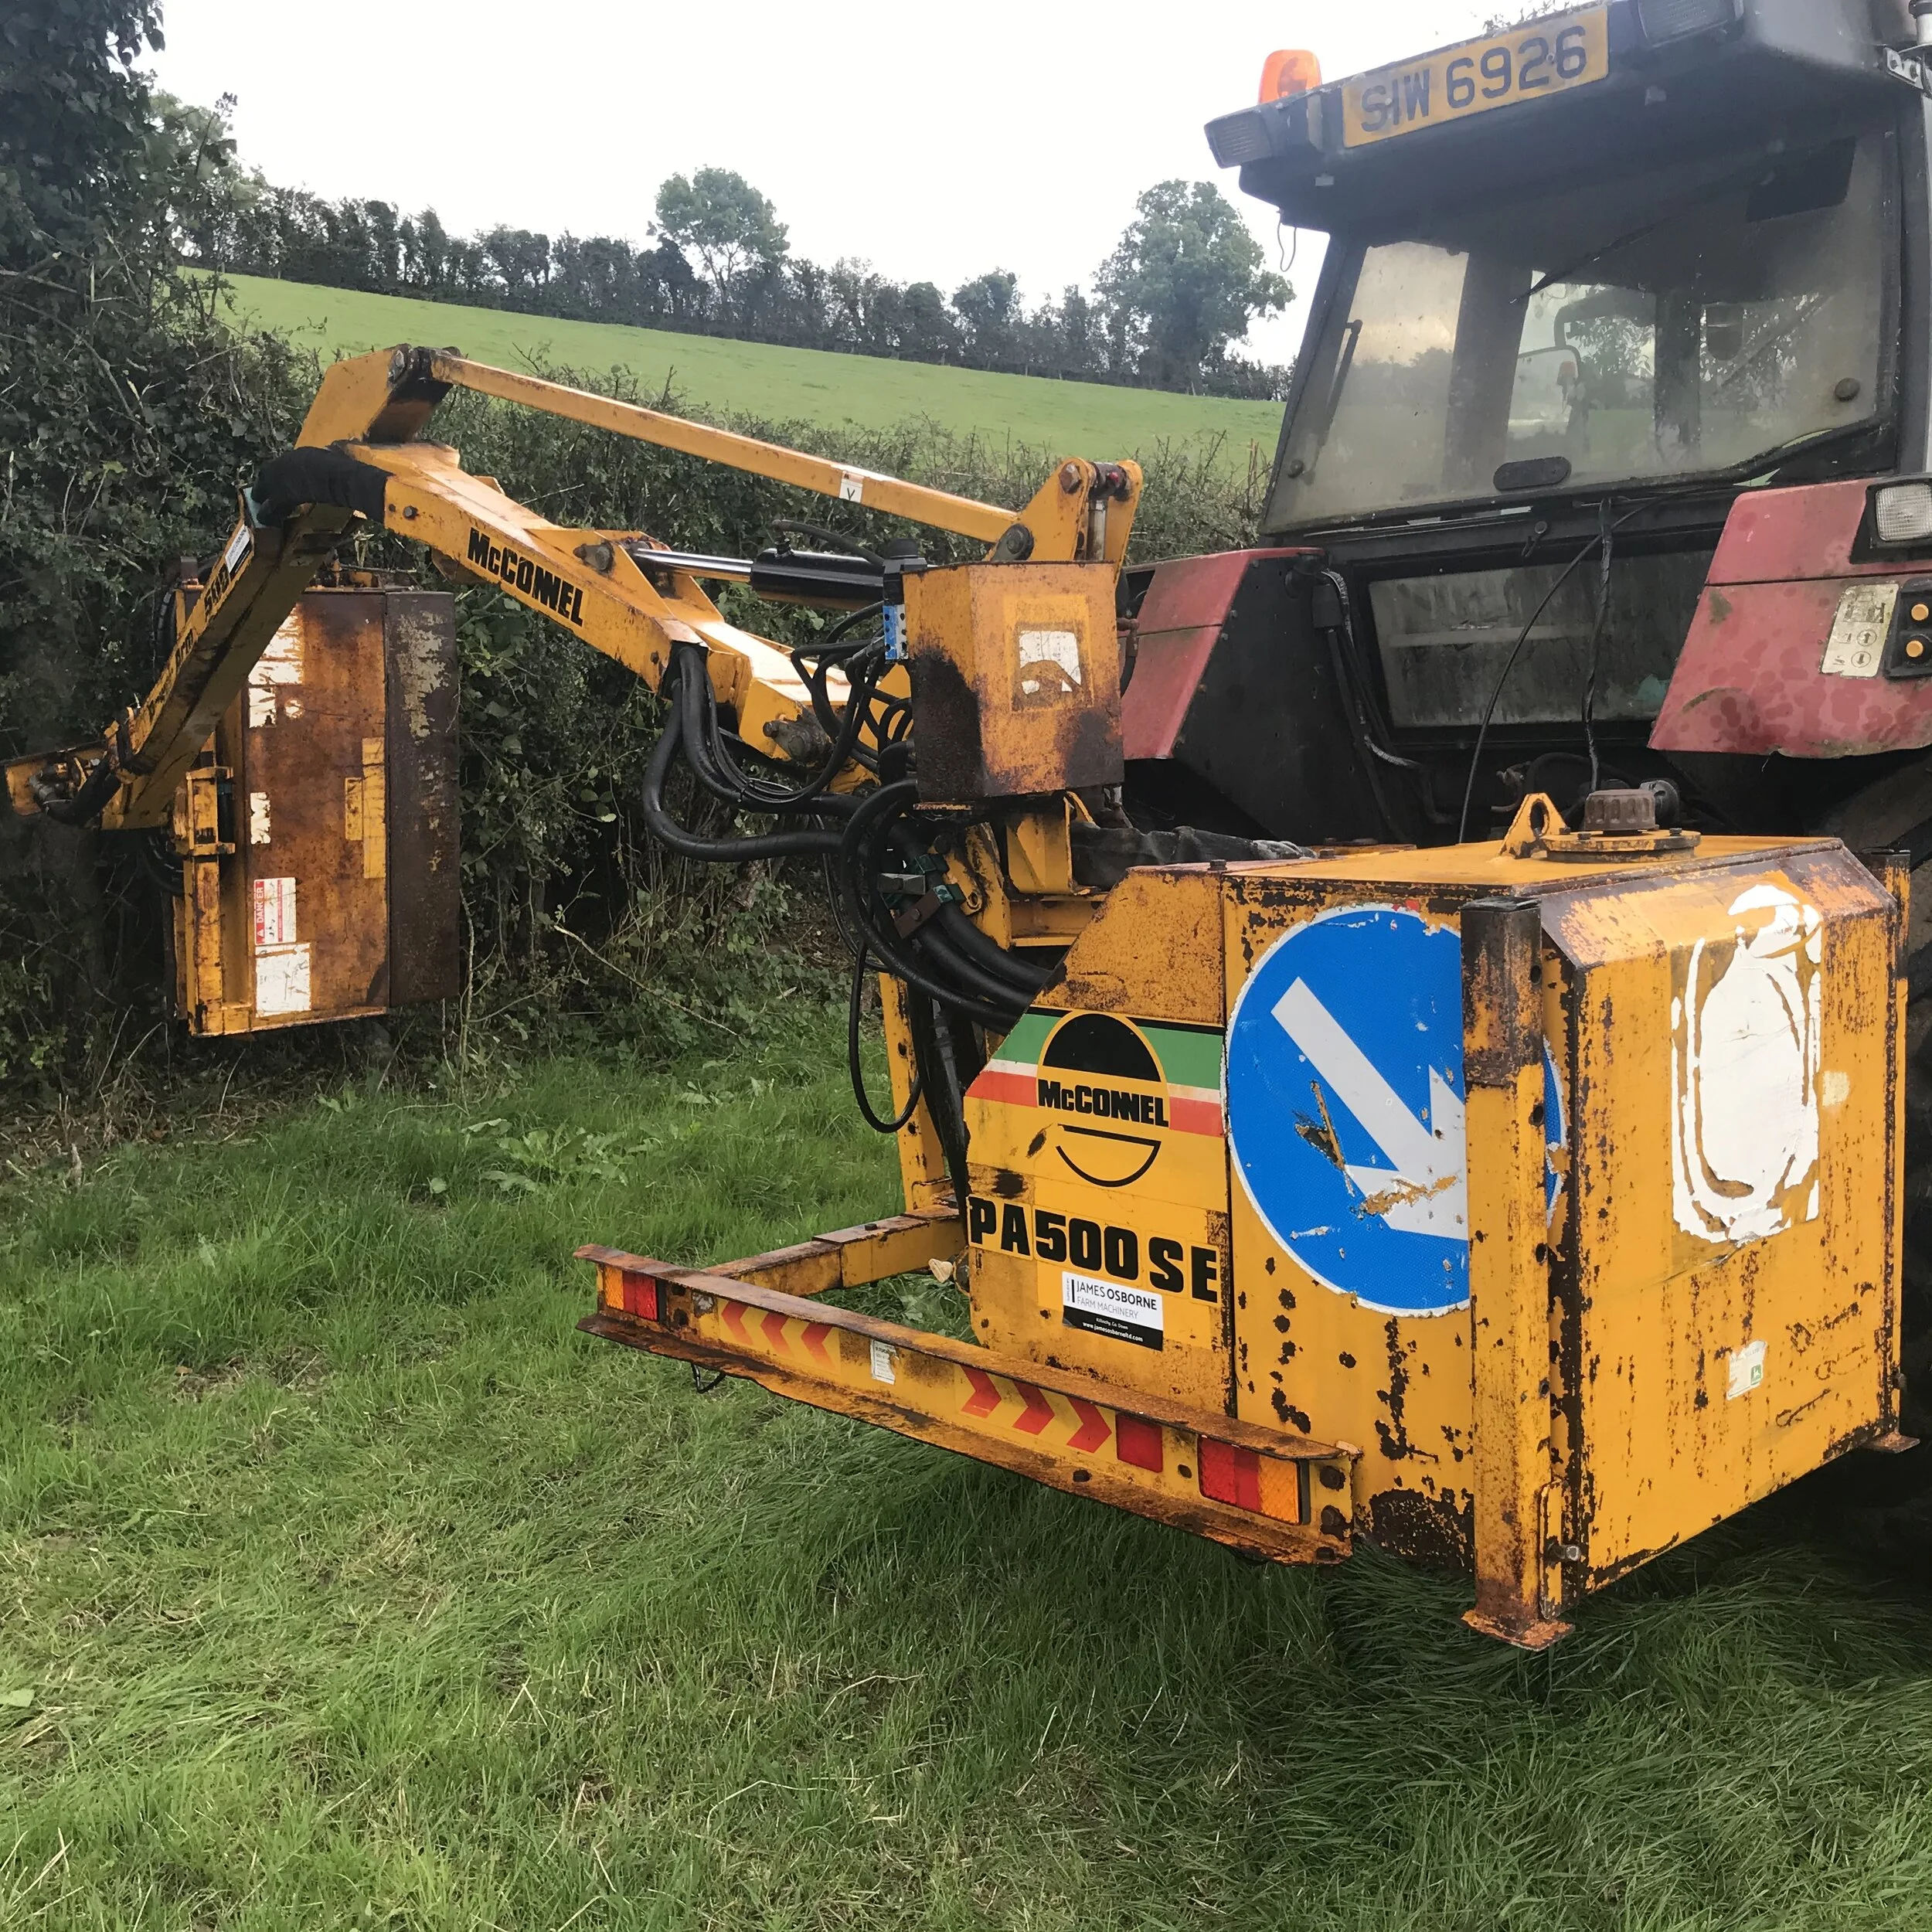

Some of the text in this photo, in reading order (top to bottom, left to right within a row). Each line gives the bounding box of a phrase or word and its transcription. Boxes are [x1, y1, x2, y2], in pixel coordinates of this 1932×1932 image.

[1361, 26, 1586, 133] SIW 6926
[968, 1196, 1218, 1304] PA500 SE
[1077, 1281, 1105, 1298] JAMES
[1107, 1288, 1158, 1310] OSBORNE
[1077, 1296, 1138, 1319] FARM MACHINERY
